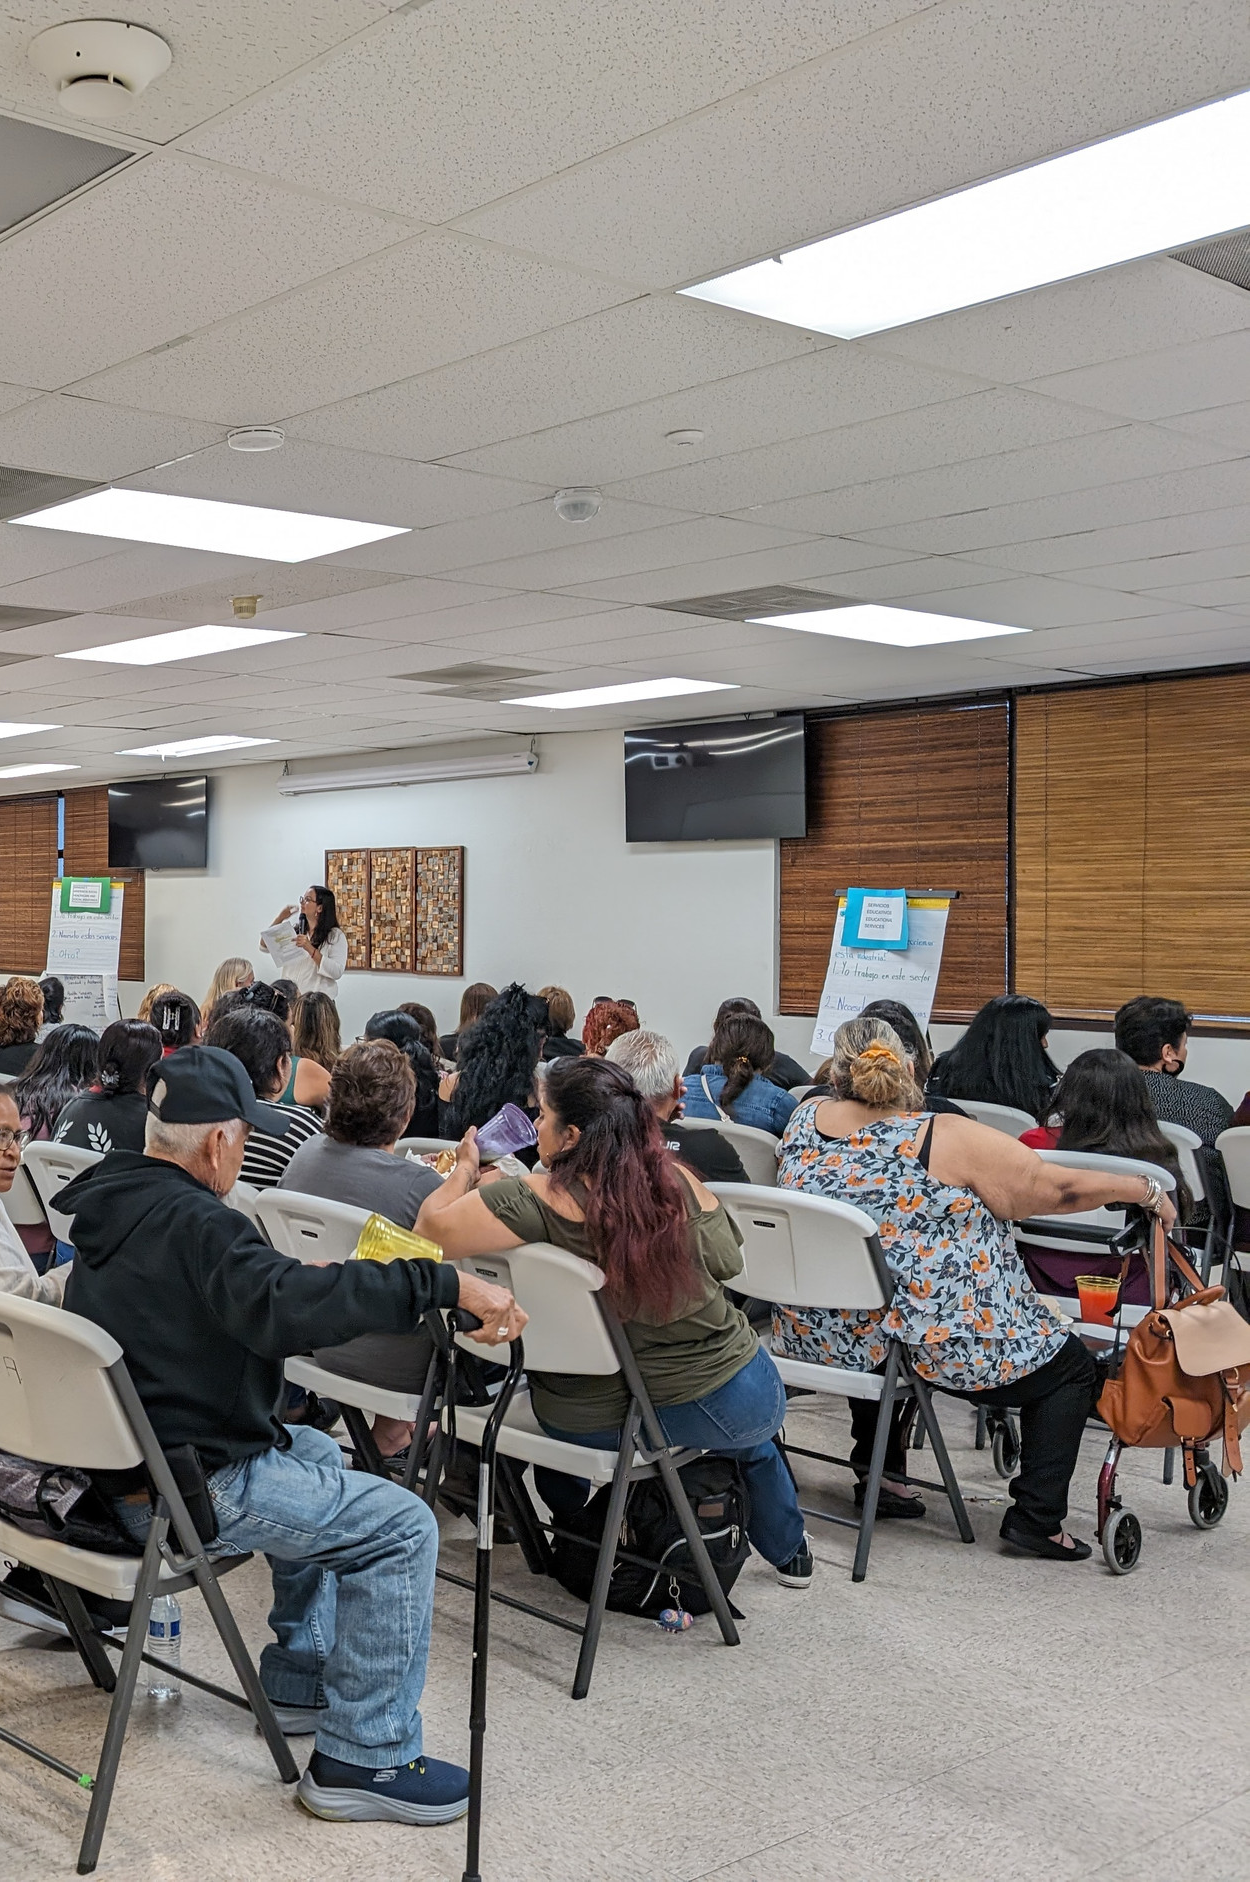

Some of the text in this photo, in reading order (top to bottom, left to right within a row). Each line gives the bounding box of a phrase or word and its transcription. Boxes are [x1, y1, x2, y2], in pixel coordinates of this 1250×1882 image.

[834, 947, 853, 959] esta
[842, 961, 850, 976] Yo
[854, 963, 879, 981] trabajo
[892, 968, 905, 980] este
